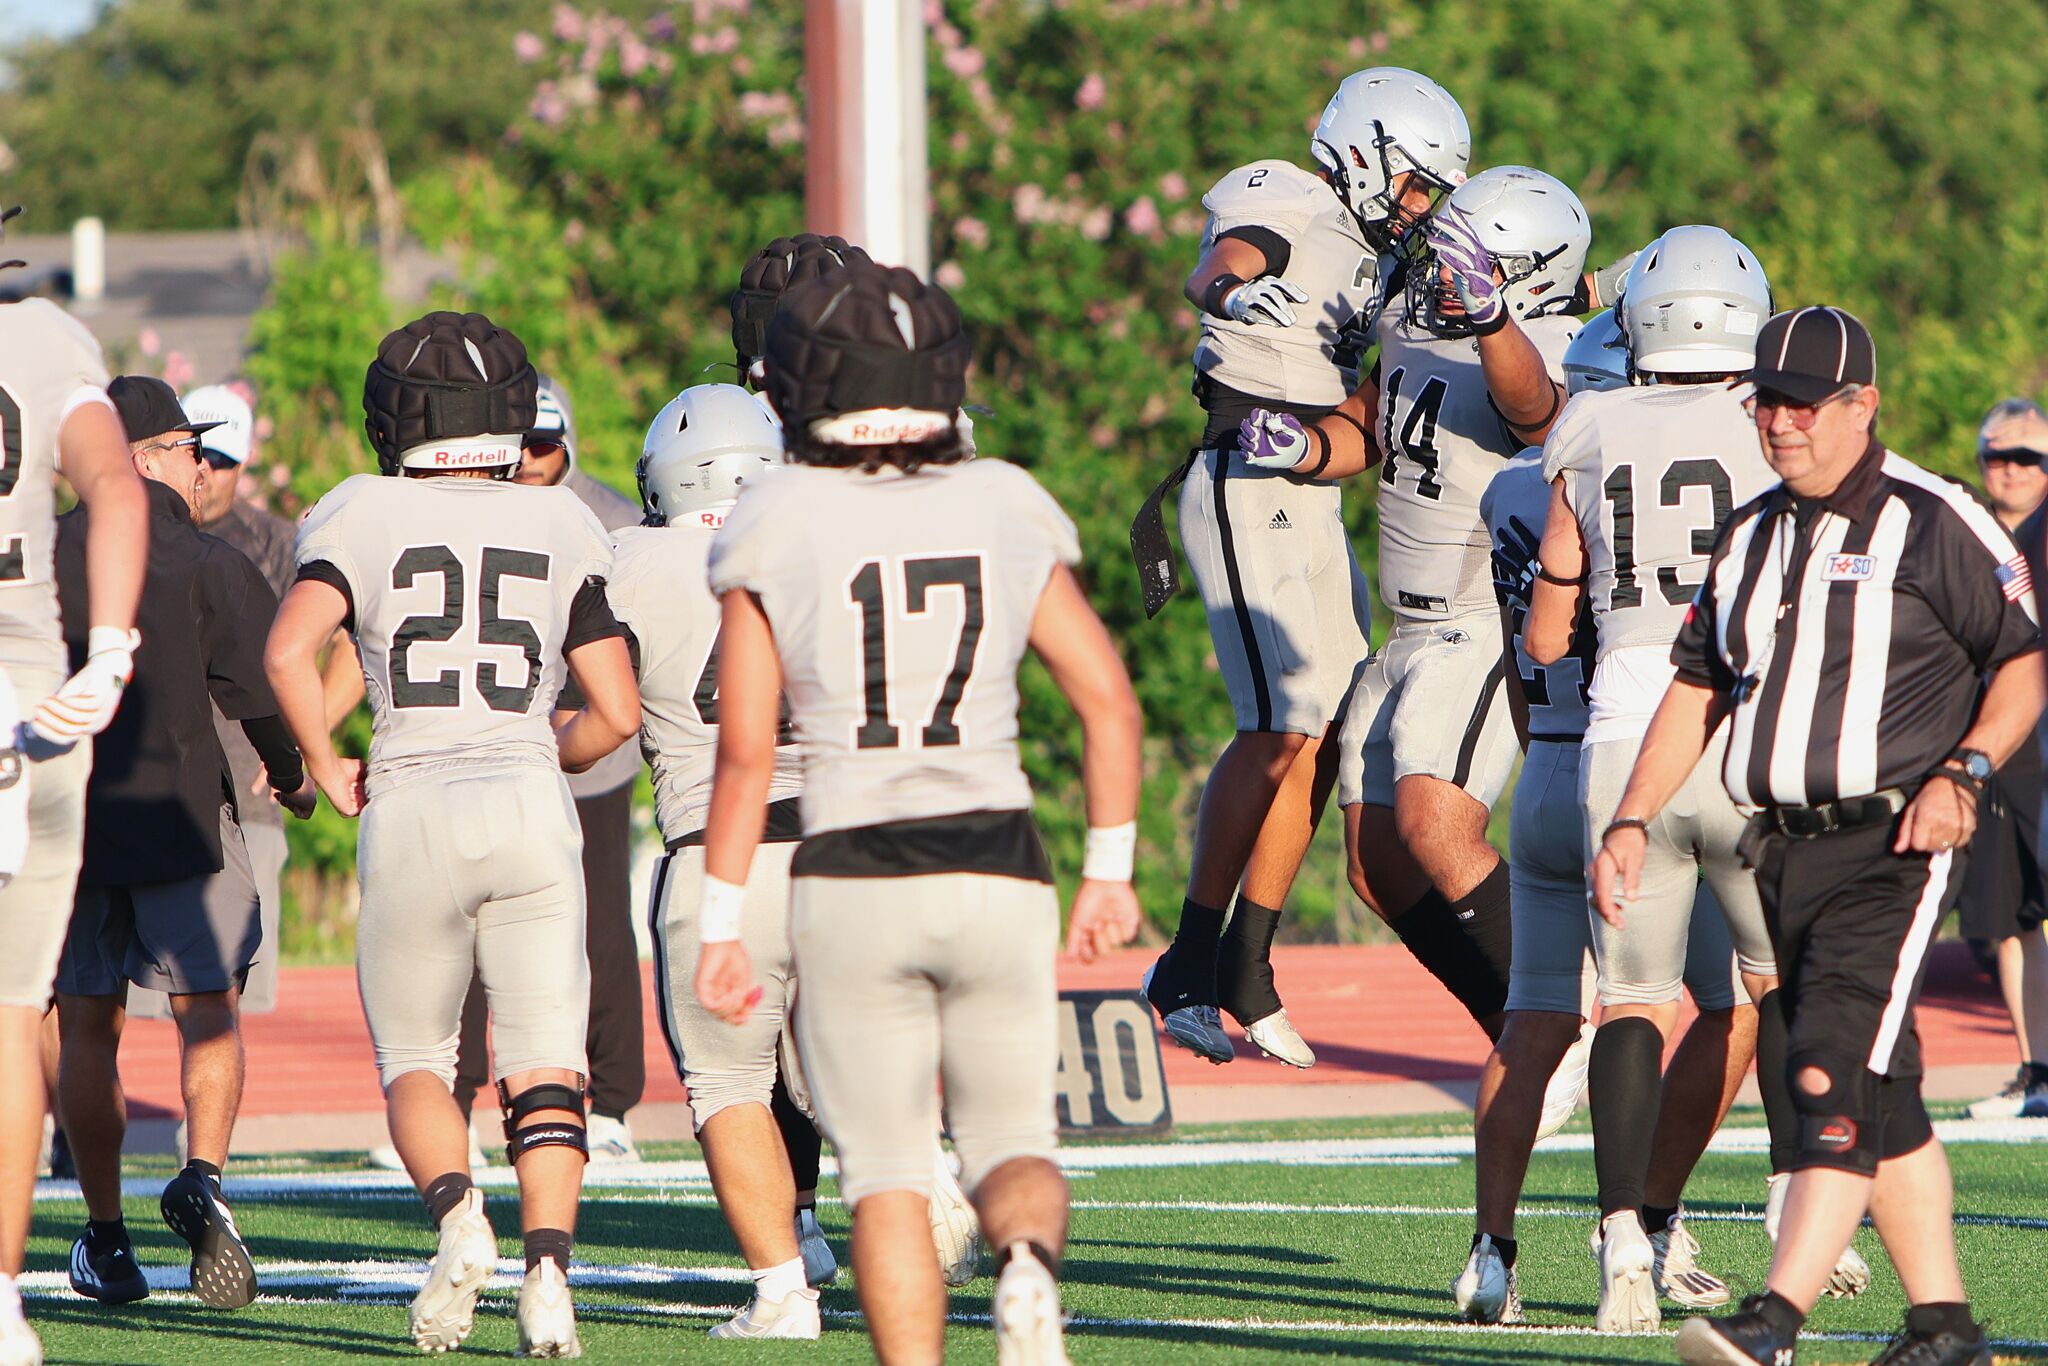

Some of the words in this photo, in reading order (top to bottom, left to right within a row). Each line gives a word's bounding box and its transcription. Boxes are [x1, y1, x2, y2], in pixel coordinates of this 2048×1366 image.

[1246, 168, 1270, 189] 2
[435, 449, 507, 465] Riddell
[1380, 365, 1448, 502] 14
[1602, 457, 1736, 611] 13
[388, 544, 552, 716] 25
[846, 552, 986, 751] 17
[1056, 999, 1166, 1126] 40
[523, 1130, 573, 1145] DONJOY
